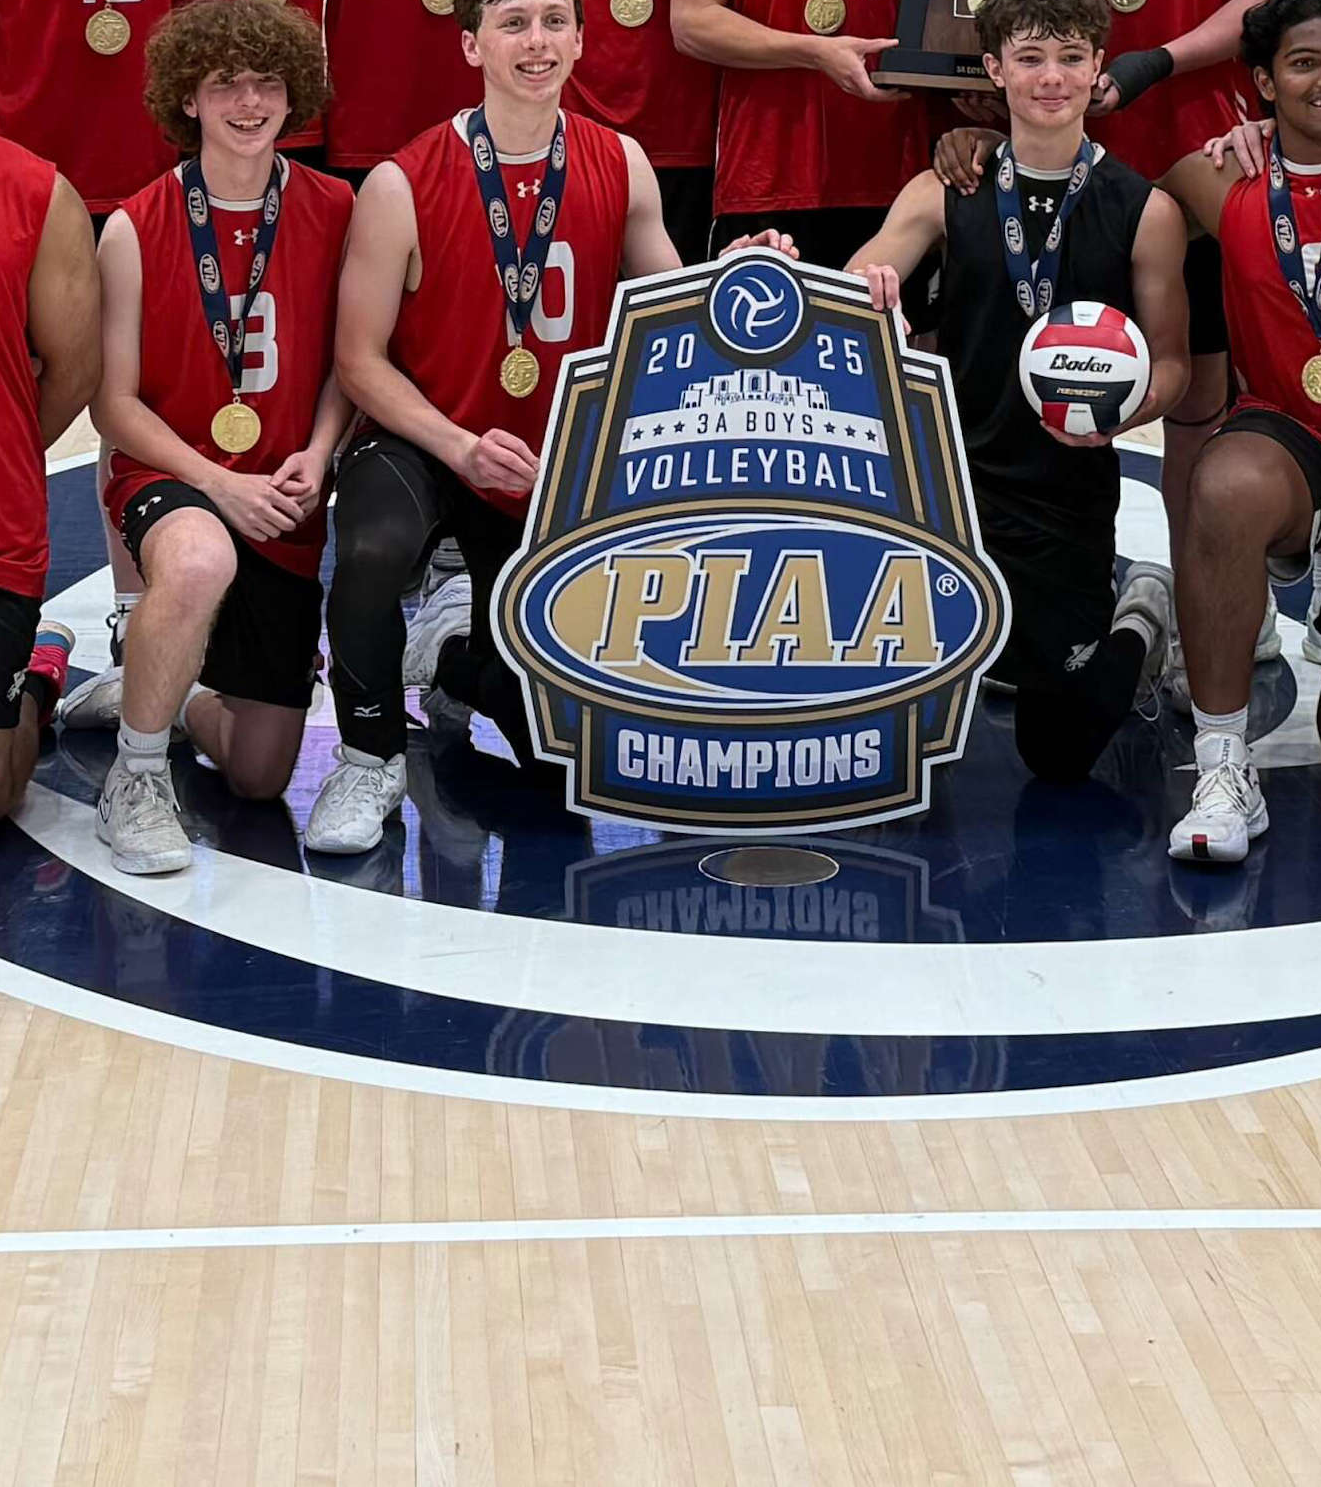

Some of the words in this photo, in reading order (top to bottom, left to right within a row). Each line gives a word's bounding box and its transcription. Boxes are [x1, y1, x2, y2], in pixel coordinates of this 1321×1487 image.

[646, 332, 695, 375] 20
[817, 334, 863, 375] 25
[1049, 353, 1112, 373] Baden
[698, 413, 728, 434] 3A
[745, 411, 814, 436] BOYS
[624, 448, 887, 498] VOLLEYBALL
[593, 549, 944, 668] PIAA
[617, 728, 882, 789] CHAMPIONS
